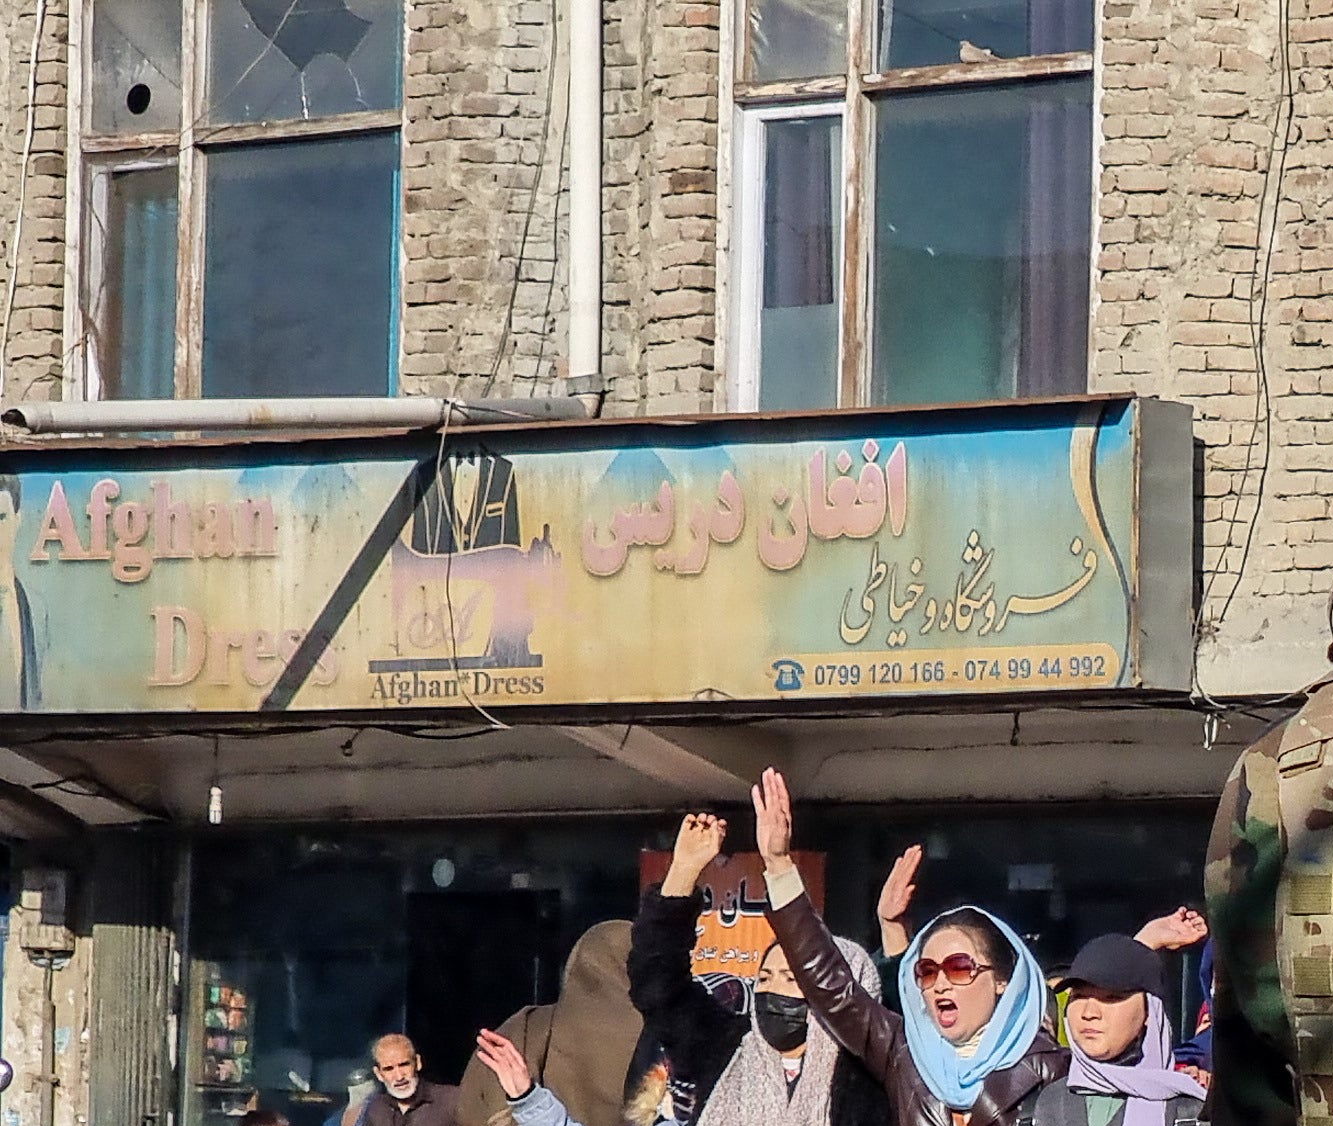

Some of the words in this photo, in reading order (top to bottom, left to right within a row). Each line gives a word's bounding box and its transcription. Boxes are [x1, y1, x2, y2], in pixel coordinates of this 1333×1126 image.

[29, 478, 279, 584] Afghan
[580, 469, 746, 577] دریس
[757, 439, 908, 571] افغان
[839, 541, 926, 648] خیاطی
[919, 597, 938, 636] و
[938, 529, 1099, 637] فروشگاه
[370, 672, 459, 705] Afghan
[472, 670, 545, 696] Dress
[813, 664, 861, 686] 0799
[868, 662, 902, 684] 120
[909, 660, 945, 683] 166
[964, 659, 1001, 681] 074
[1007, 658, 1032, 680] 99
[1038, 657, 1063, 679] 44
[1069, 655, 1107, 677] 992
